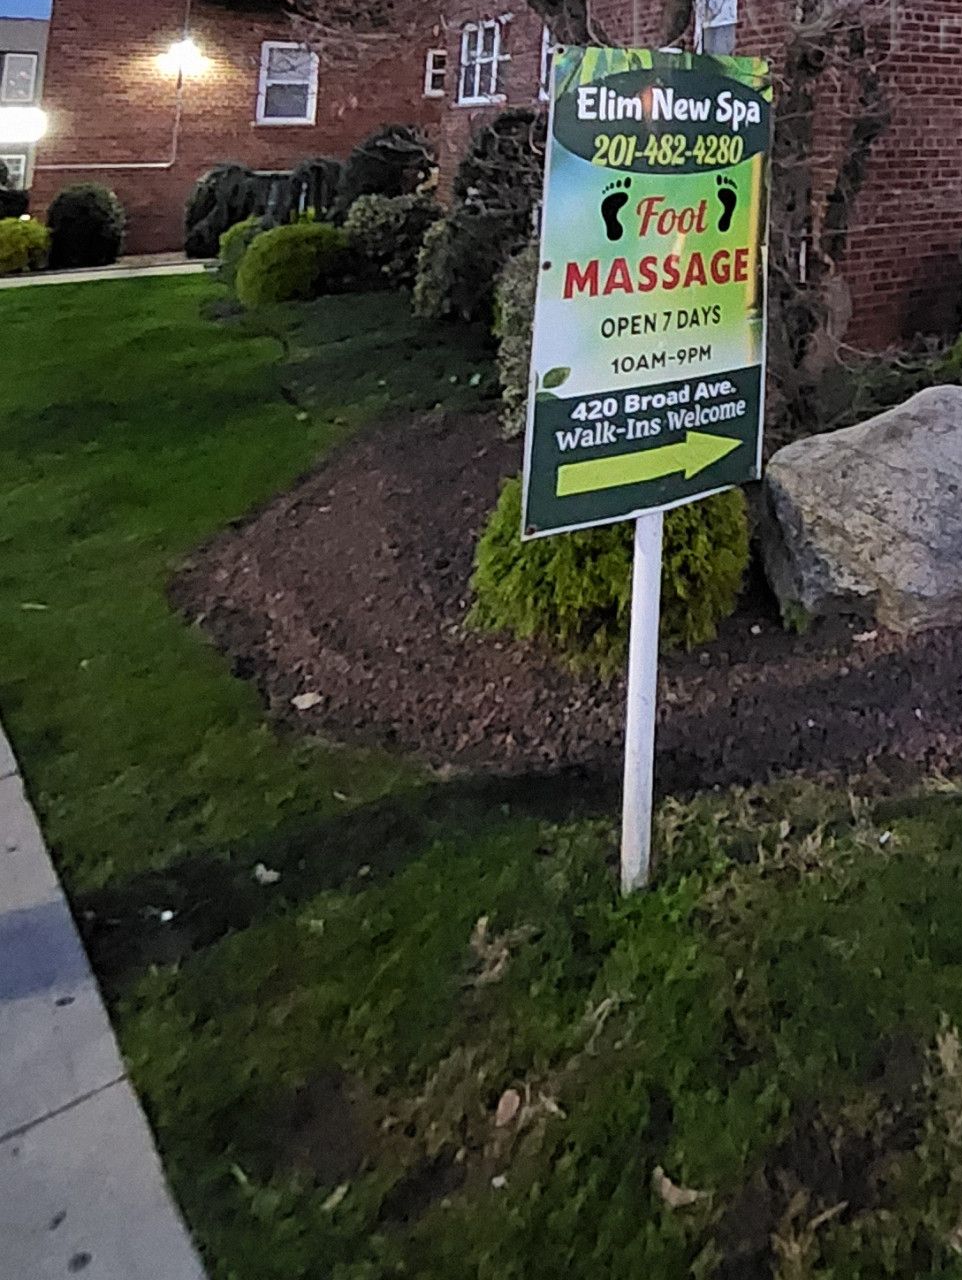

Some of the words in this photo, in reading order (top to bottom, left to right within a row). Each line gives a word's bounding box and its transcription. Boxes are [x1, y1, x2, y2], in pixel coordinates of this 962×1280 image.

[577, 86, 642, 121] Elim
[651, 87, 710, 122] New
[715, 91, 761, 131] Spa
[592, 134, 744, 166] 201-482-4280
[636, 196, 708, 237] Foot
[563, 248, 749, 299] MASSAGE
[601, 313, 657, 338] OPEN
[663, 311, 672, 331] 7
[677, 305, 721, 328] DAYS
[611, 345, 712, 374] 10AM-9PM
[570, 398, 618, 421] 420
[624, 385, 690, 413] Broad
[694, 379, 737, 401] Ave.
[555, 417, 662, 452] Walk-Ins
[666, 399, 747, 431] Welcome
